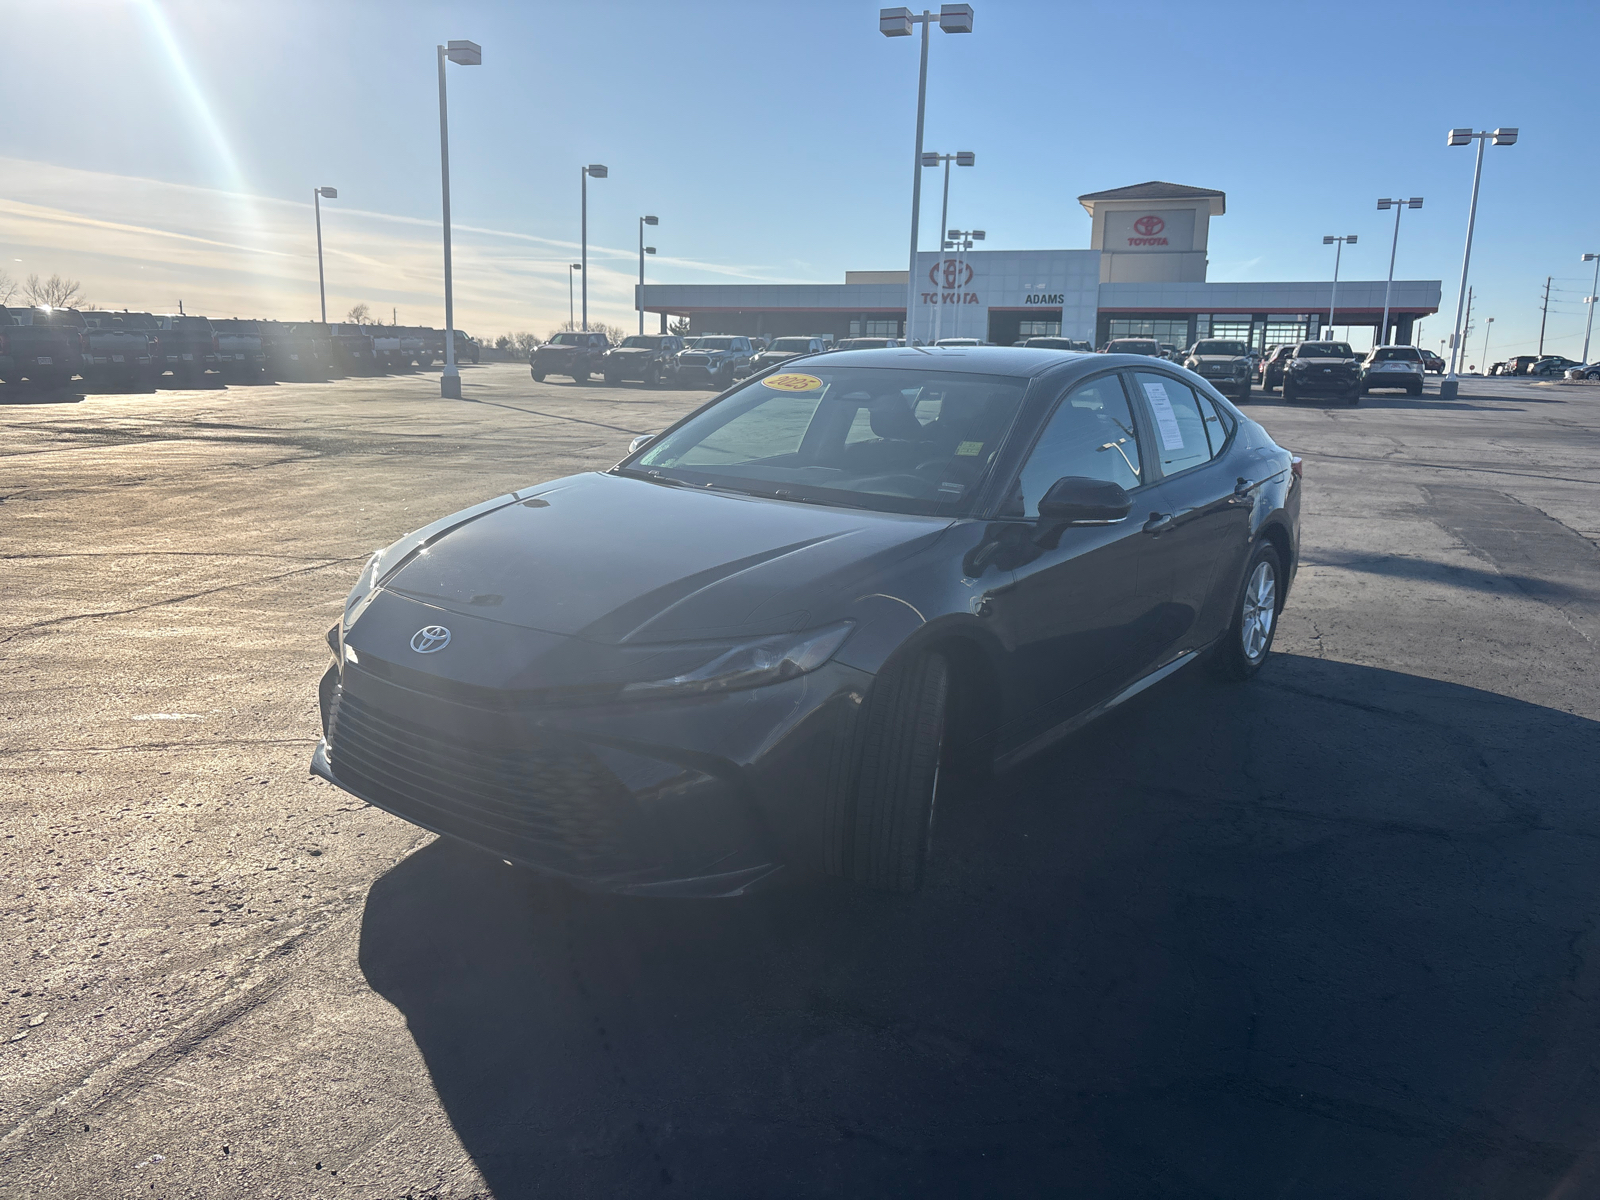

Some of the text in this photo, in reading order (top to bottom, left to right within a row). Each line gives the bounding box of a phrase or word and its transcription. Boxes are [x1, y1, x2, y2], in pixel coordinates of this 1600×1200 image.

[1127, 237, 1168, 246] TOYOTA
[921, 292, 979, 304] TOYOTA
[1025, 294, 1064, 304] ADAMS
[767, 376, 817, 389] 2025
